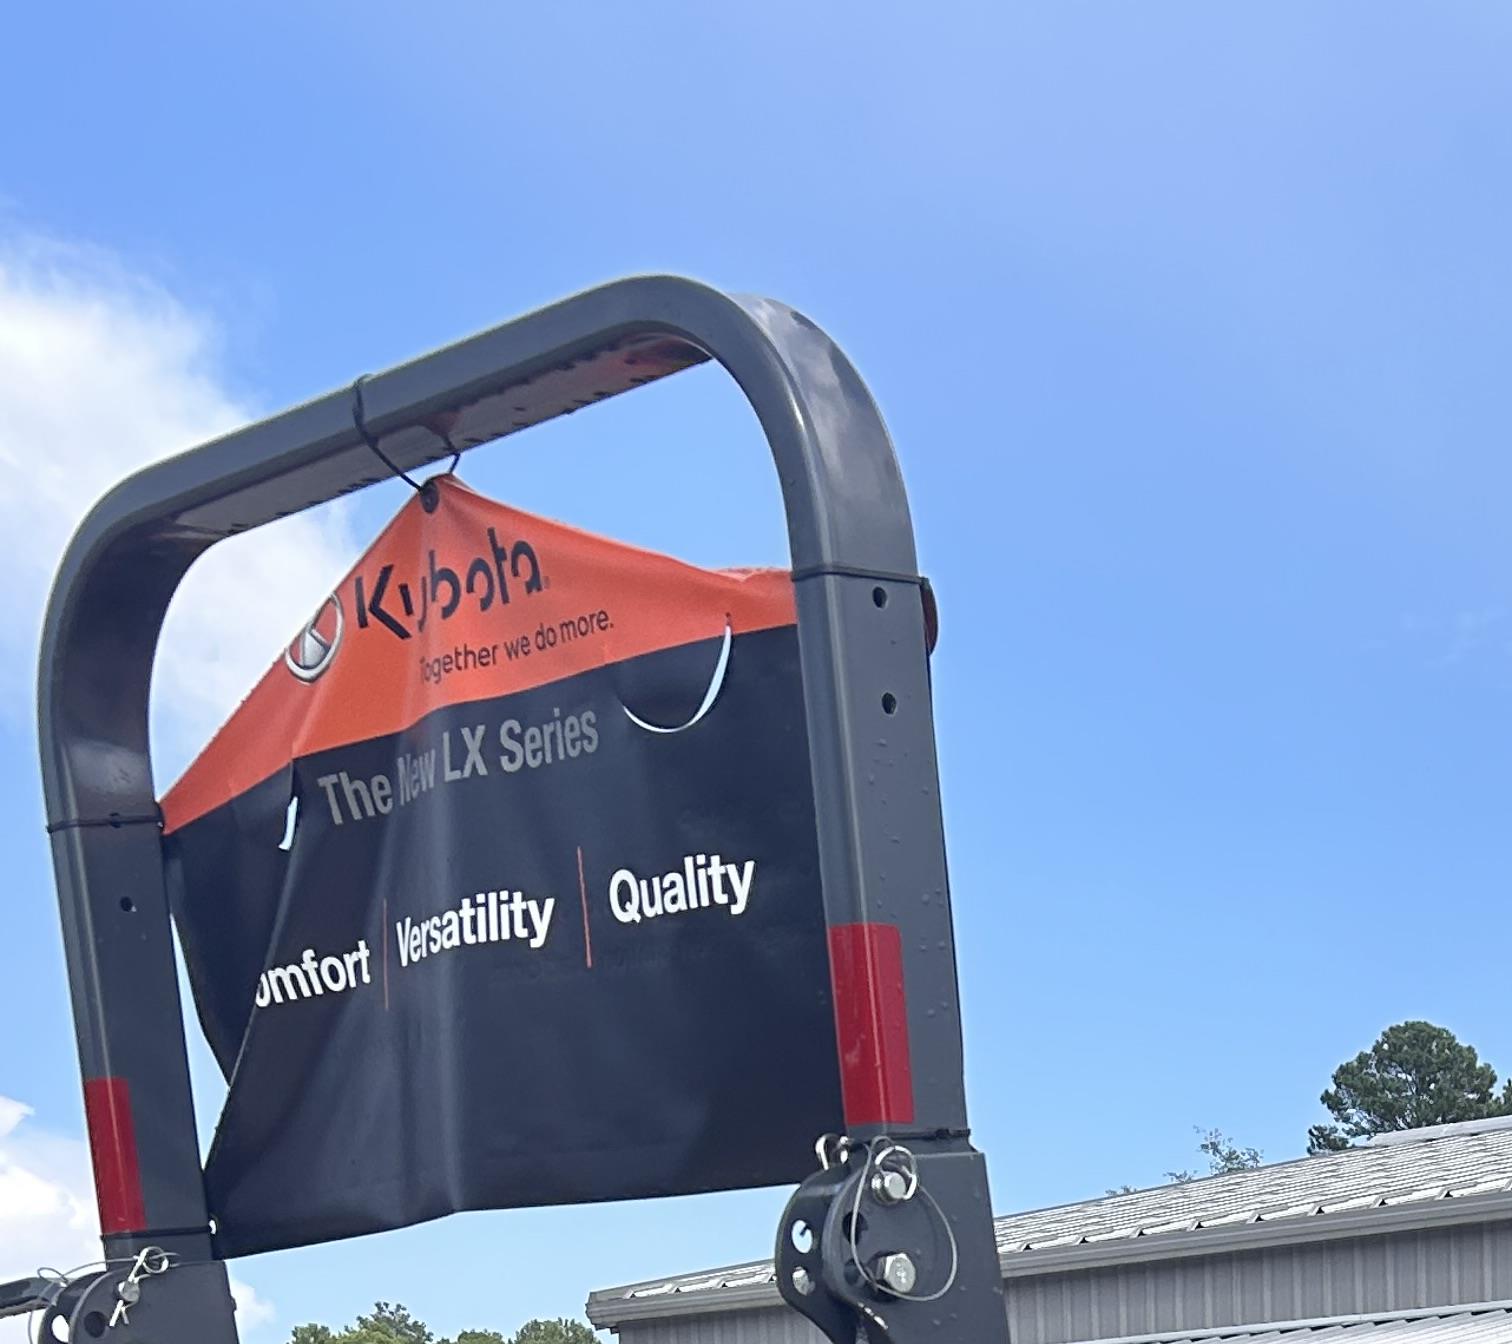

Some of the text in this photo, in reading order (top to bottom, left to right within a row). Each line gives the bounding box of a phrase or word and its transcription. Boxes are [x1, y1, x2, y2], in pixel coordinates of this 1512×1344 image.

[355, 527, 543, 640] Kubota
[503, 632, 531, 661] we
[535, 622, 557, 651] do
[561, 609, 615, 643] more.
[317, 707, 599, 825] The New LX Series
[255, 853, 755, 1007] omfort Versatility Quality
